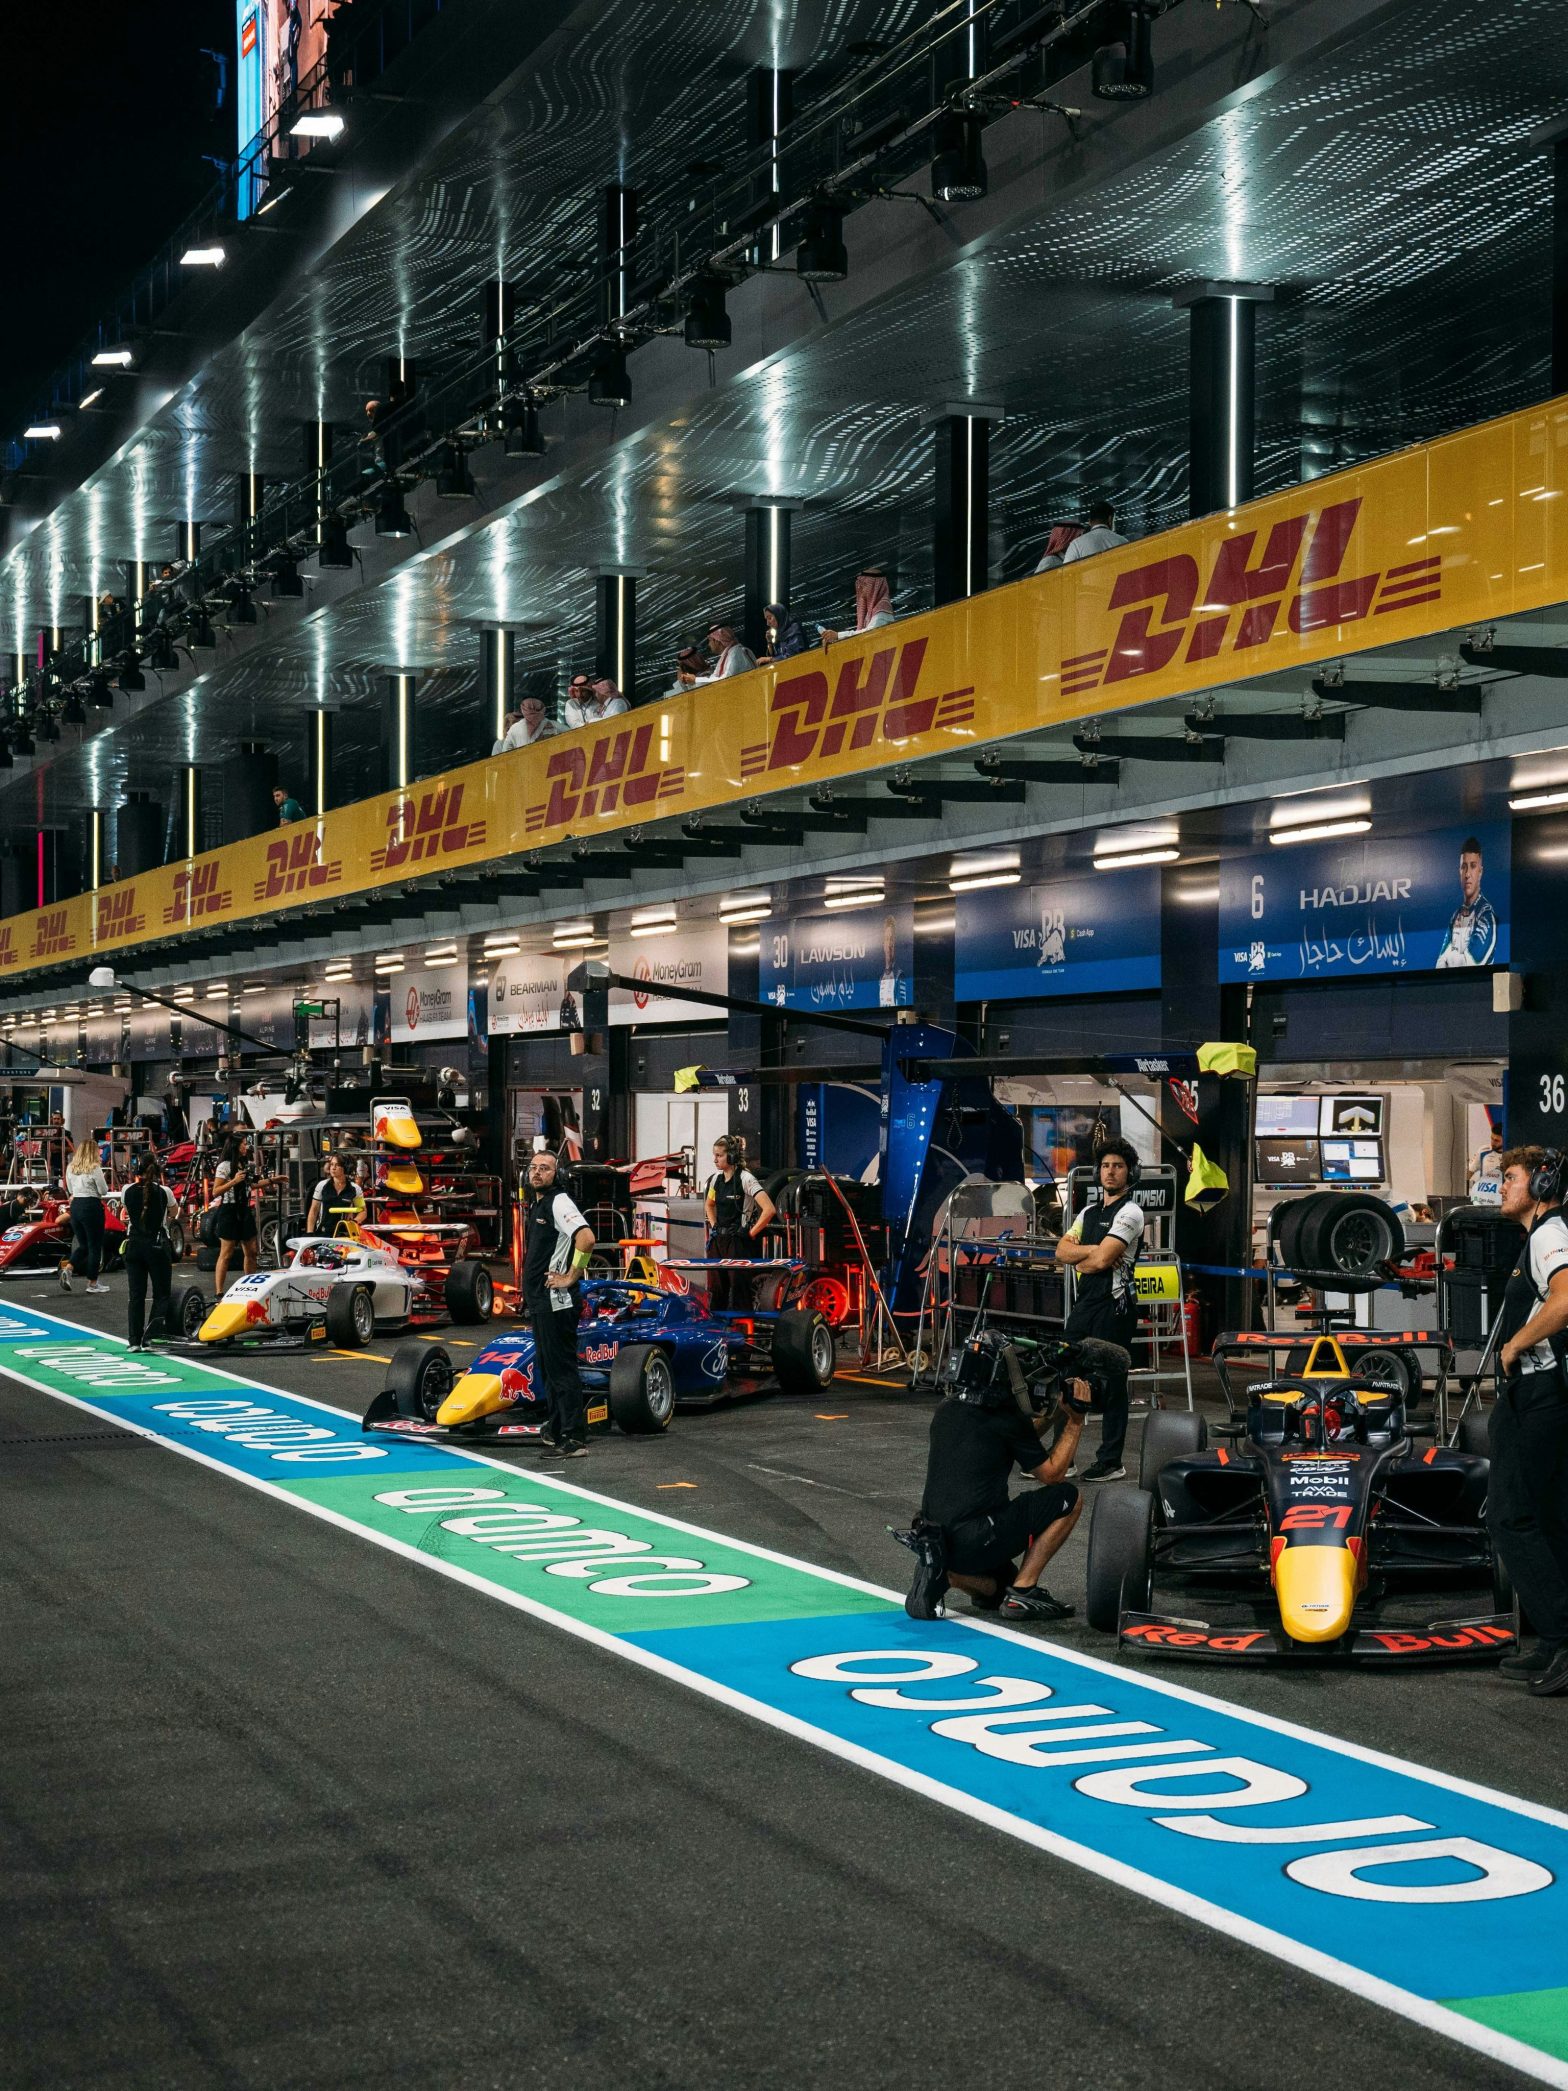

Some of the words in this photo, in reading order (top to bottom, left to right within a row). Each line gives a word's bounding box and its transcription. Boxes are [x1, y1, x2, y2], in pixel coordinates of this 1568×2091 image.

[1103, 497, 1380, 685] DHL
[768, 637, 939, 770] DHL
[545, 724, 661, 828] DHL
[384, 784, 469, 872] DHL
[265, 831, 328, 898] DHL
[172, 861, 221, 922] DHL
[1251, 875, 1264, 919] 6
[1300, 878, 1411, 909] HADJAR
[97, 888, 136, 942] DHL
[36, 911, 68, 958] DHL
[1012, 929, 1036, 949] VISA
[773, 935, 788, 968] 30
[801, 944, 866, 964] LAWSON
[1233, 952, 1248, 963] VISA
[653, 961, 702, 984] MoneyGram
[420, 989, 452, 1008] MoneyGram
[510, 980, 558, 996] BEARMAN
[592, 1089, 600, 1110] 32
[738, 1088, 749, 1112] 33
[1540, 1074, 1565, 1113] 36
[907, 1114, 915, 1129] 6
[1477, 1183, 1498, 1194] VISA
[241, 1275, 271, 1284] 18
[586, 1344, 602, 1363] Red
[602, 1341, 619, 1360] Bull
[1337, 1332, 1428, 1343] Bull
[14, 1346, 183, 1387] aramco
[478, 1351, 524, 1365] 14
[152, 1400, 389, 1462] aramco
[1280, 1504, 1353, 1531] 21
[372, 1487, 752, 1597] aramco
[1123, 1624, 1267, 1652] Red
[1373, 1626, 1514, 1653] Bull
[790, 1650, 1554, 1904] aramco
